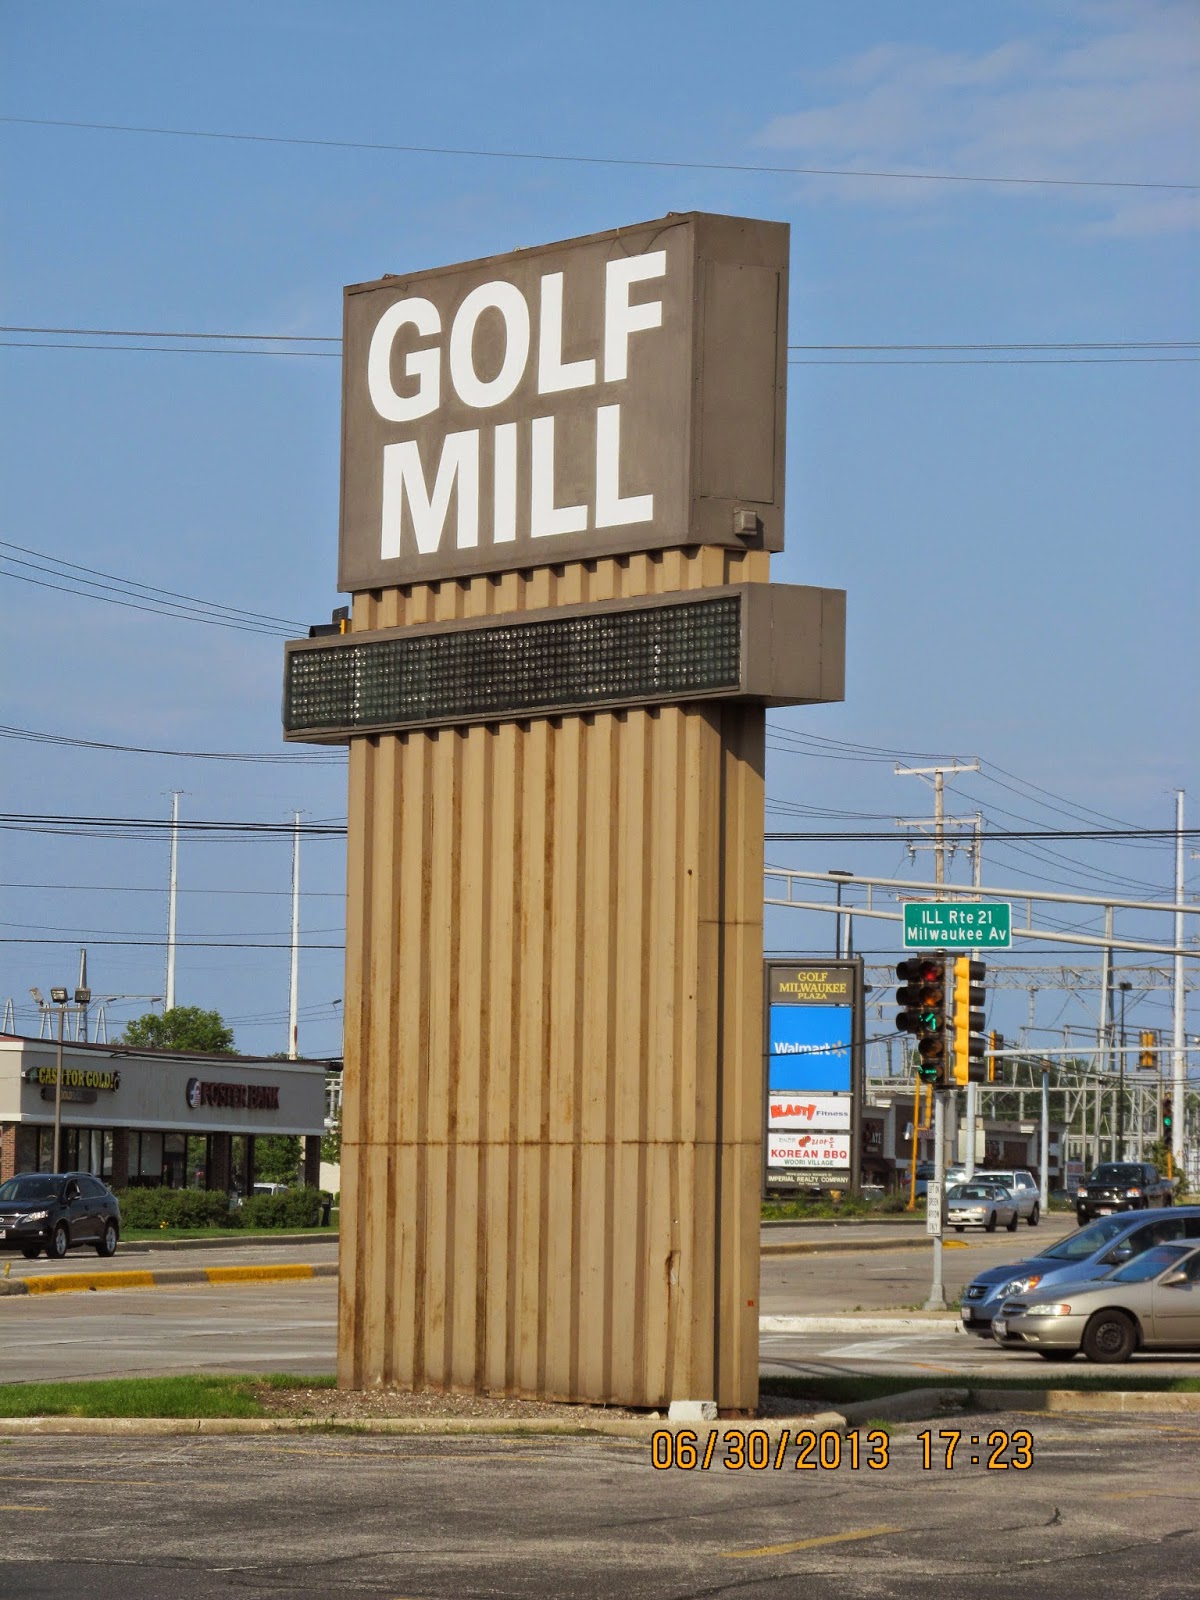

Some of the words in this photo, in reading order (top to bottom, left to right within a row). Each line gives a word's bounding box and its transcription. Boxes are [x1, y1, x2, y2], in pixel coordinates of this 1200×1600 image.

[368, 250, 666, 422] GOLF
[381, 404, 653, 560] MILL
[922, 911, 943, 924] ILL
[949, 911, 974, 924] Rte
[978, 911, 992, 924] 21
[907, 927, 983, 940] Milwaukee
[989, 927, 1007, 940] Av
[797, 972, 828, 982] GOLF
[779, 982, 847, 993] MILWAUKEE
[797, 992, 827, 1000] PLAZA
[774, 1042, 831, 1056] Walmart
[770, 1104, 817, 1121] BLAST!
[771, 1149, 819, 1158] KOREAN
[823, 1150, 847, 1159] BBQ
